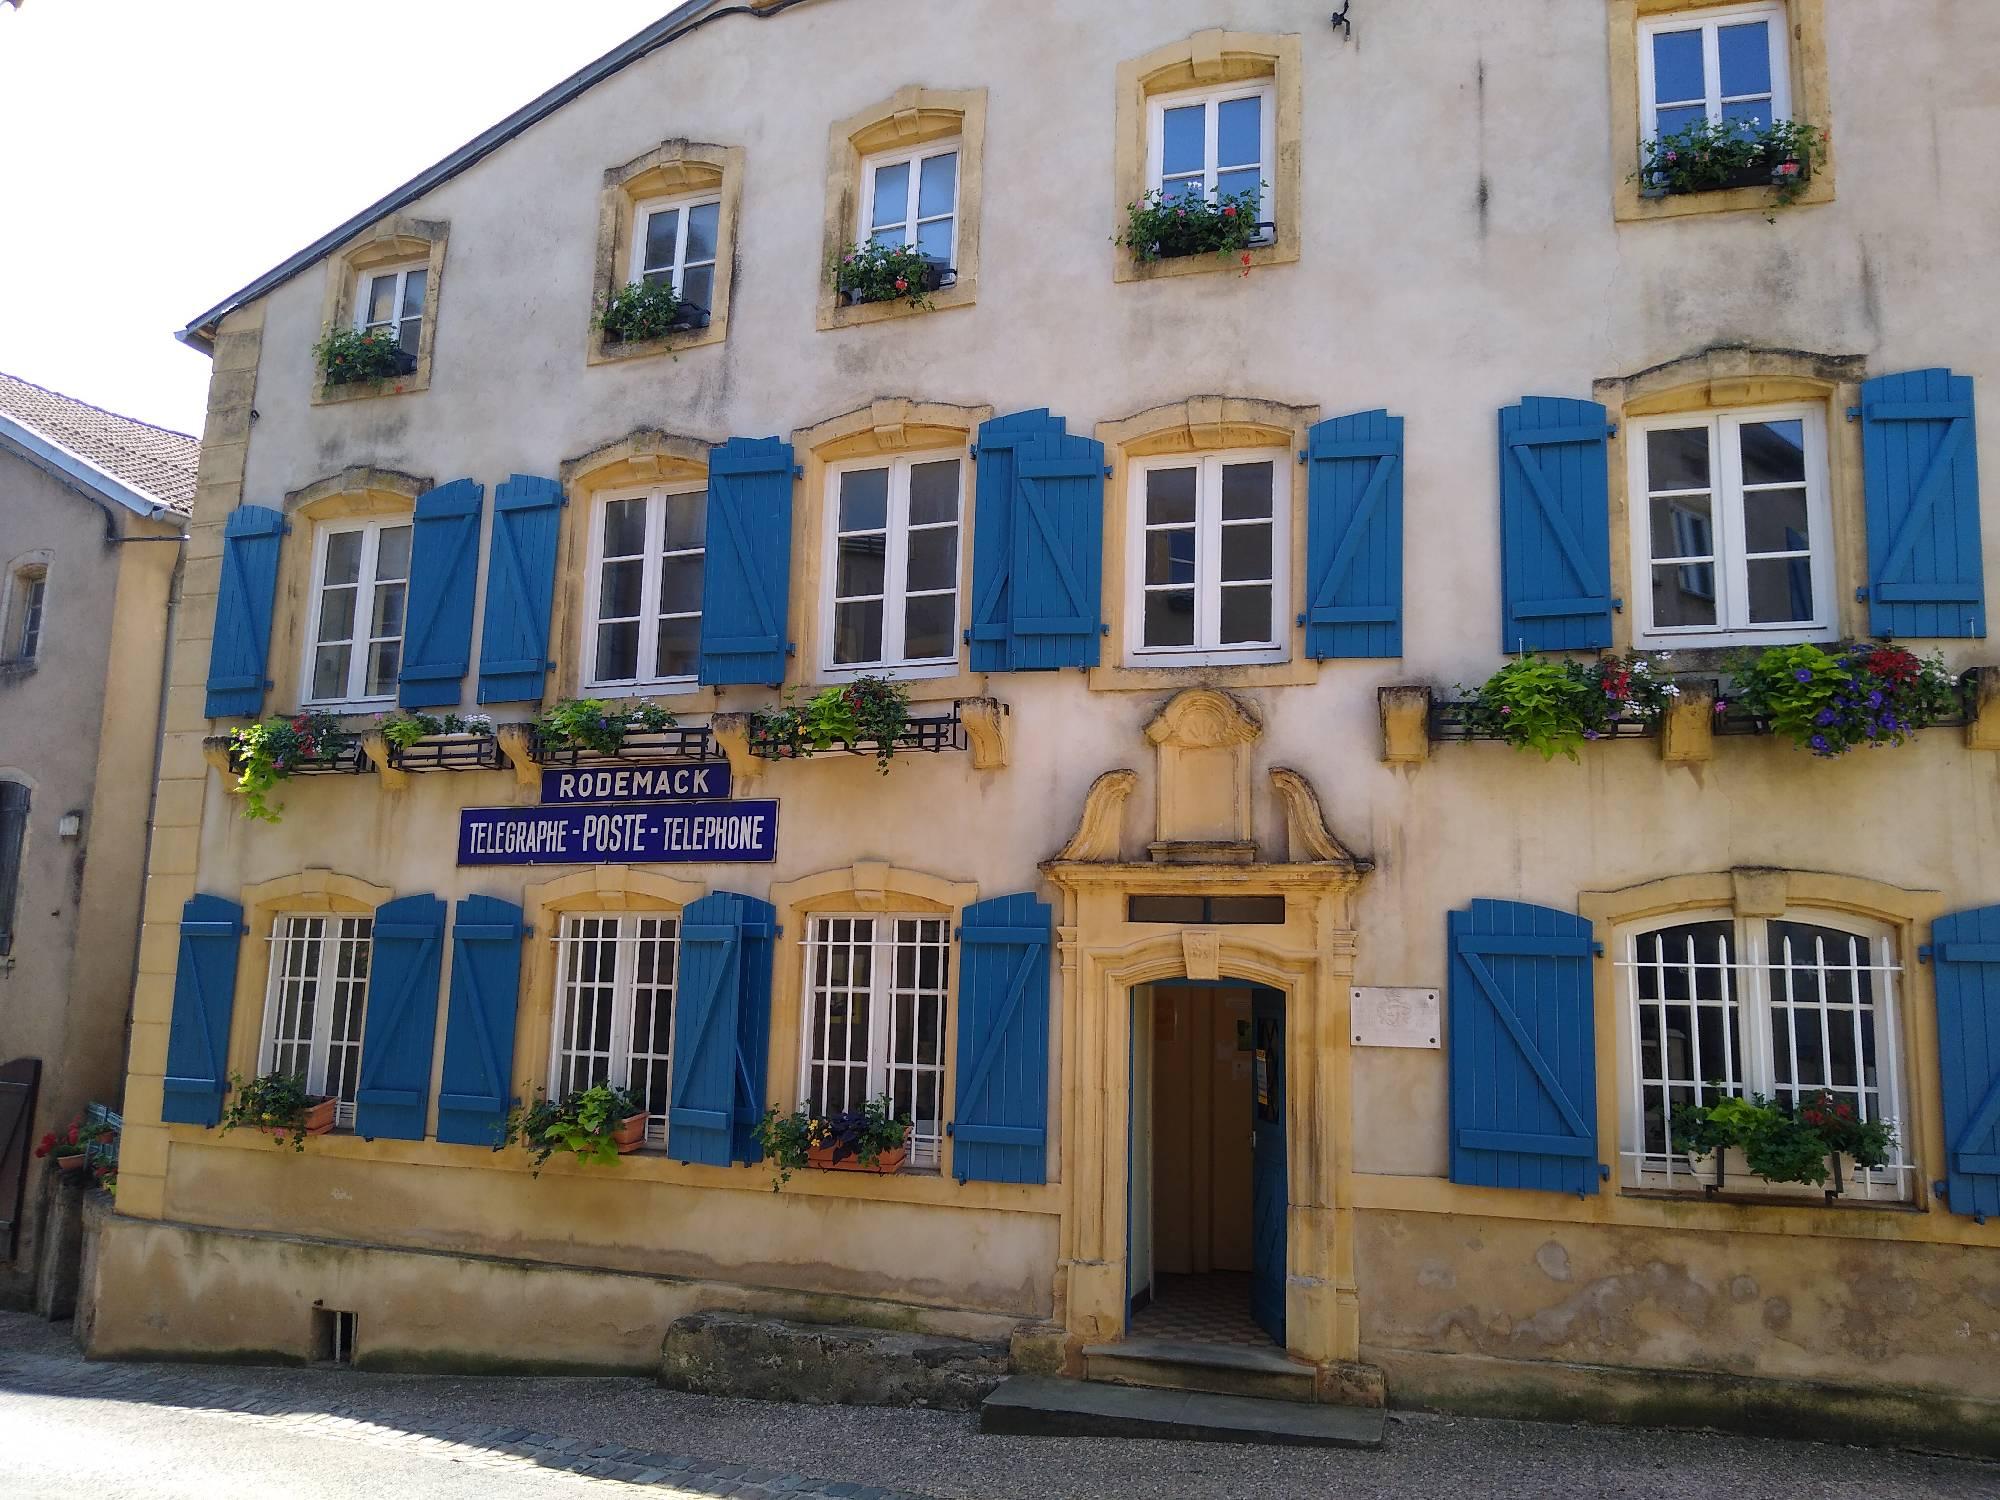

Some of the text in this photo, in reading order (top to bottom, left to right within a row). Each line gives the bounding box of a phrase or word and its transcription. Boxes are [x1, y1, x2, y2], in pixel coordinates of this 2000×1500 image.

[559, 769, 710, 798] RODEMACK
[469, 819, 569, 854] TELEGRAPHE
[581, 813, 648, 852] POSTE
[662, 815, 765, 851] TELEPHONE
